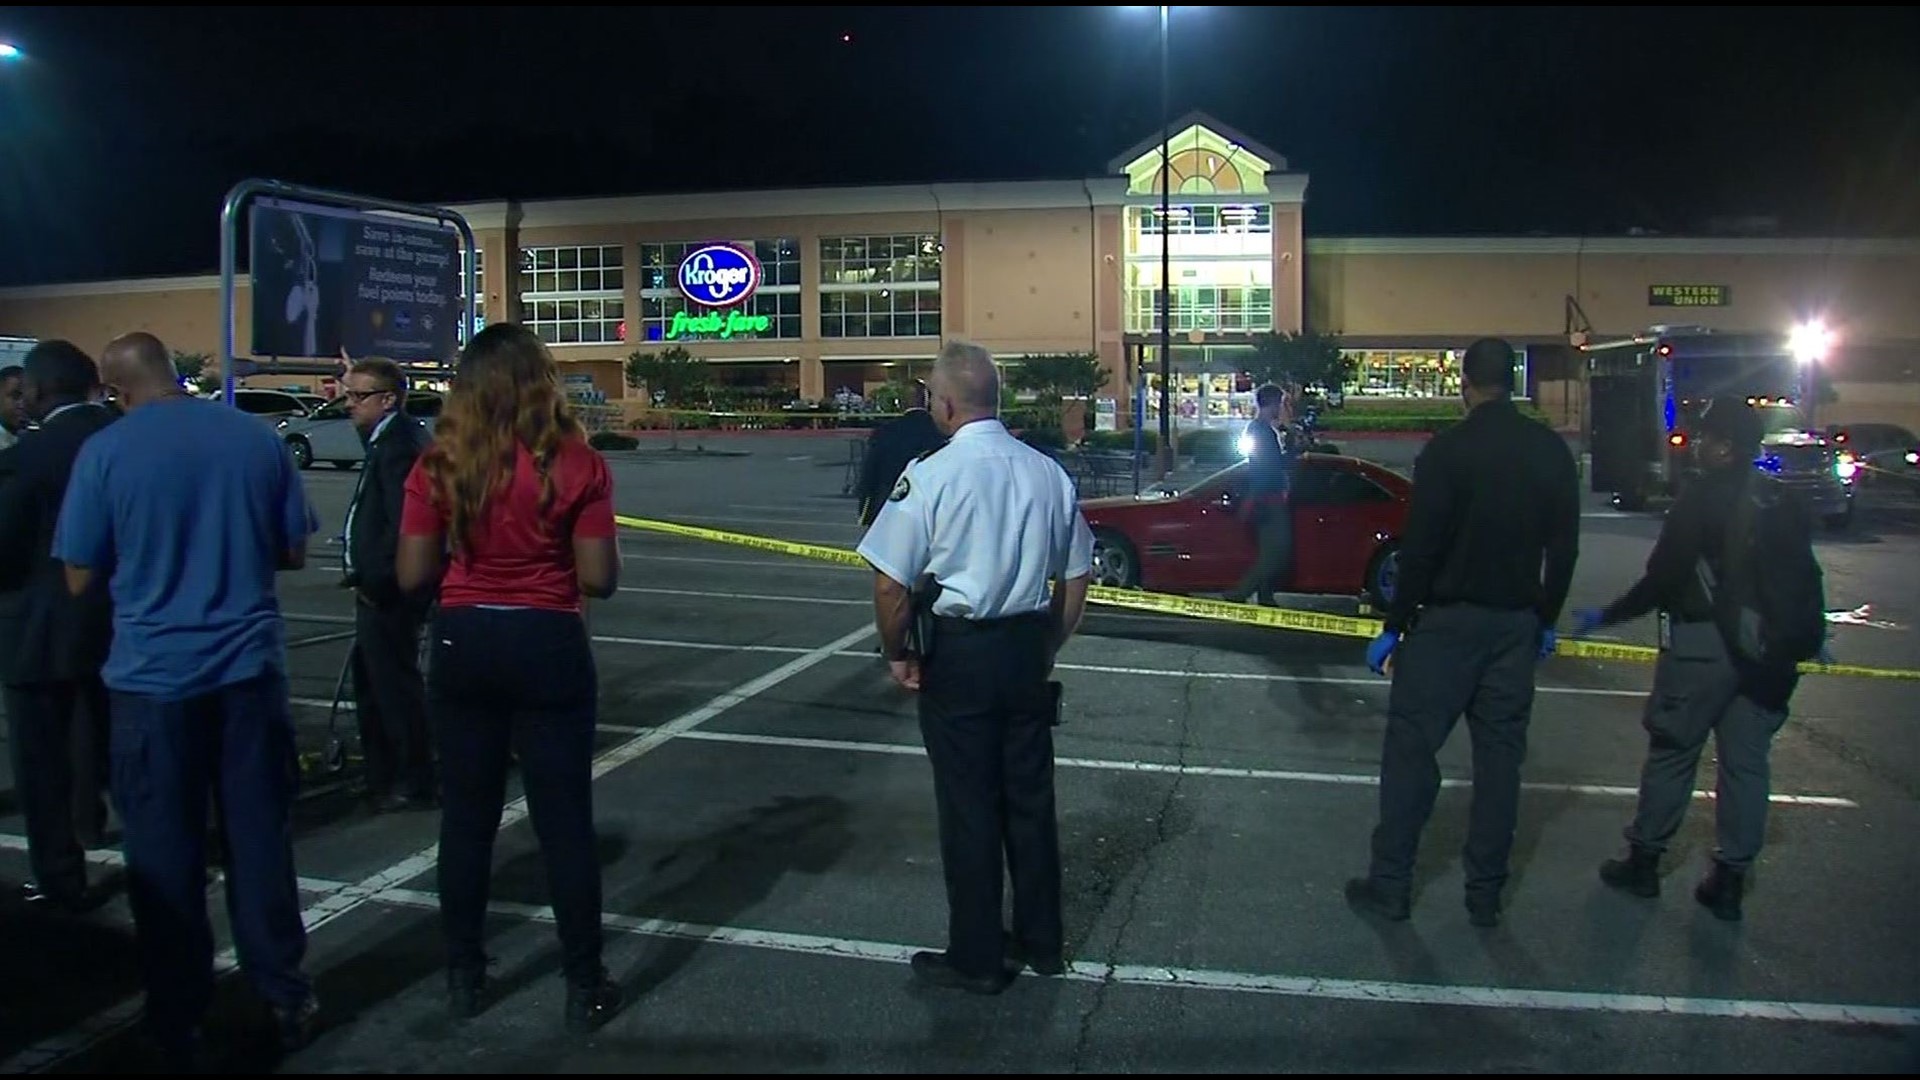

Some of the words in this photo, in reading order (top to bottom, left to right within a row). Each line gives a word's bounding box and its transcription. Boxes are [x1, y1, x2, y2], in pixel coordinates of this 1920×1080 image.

[396, 246, 414, 260] the
[368, 266, 413, 284] Redeem
[685, 253, 748, 298] Kroger
[1652, 286, 1719, 296] WESTERN
[1673, 296, 1719, 305] UNION
